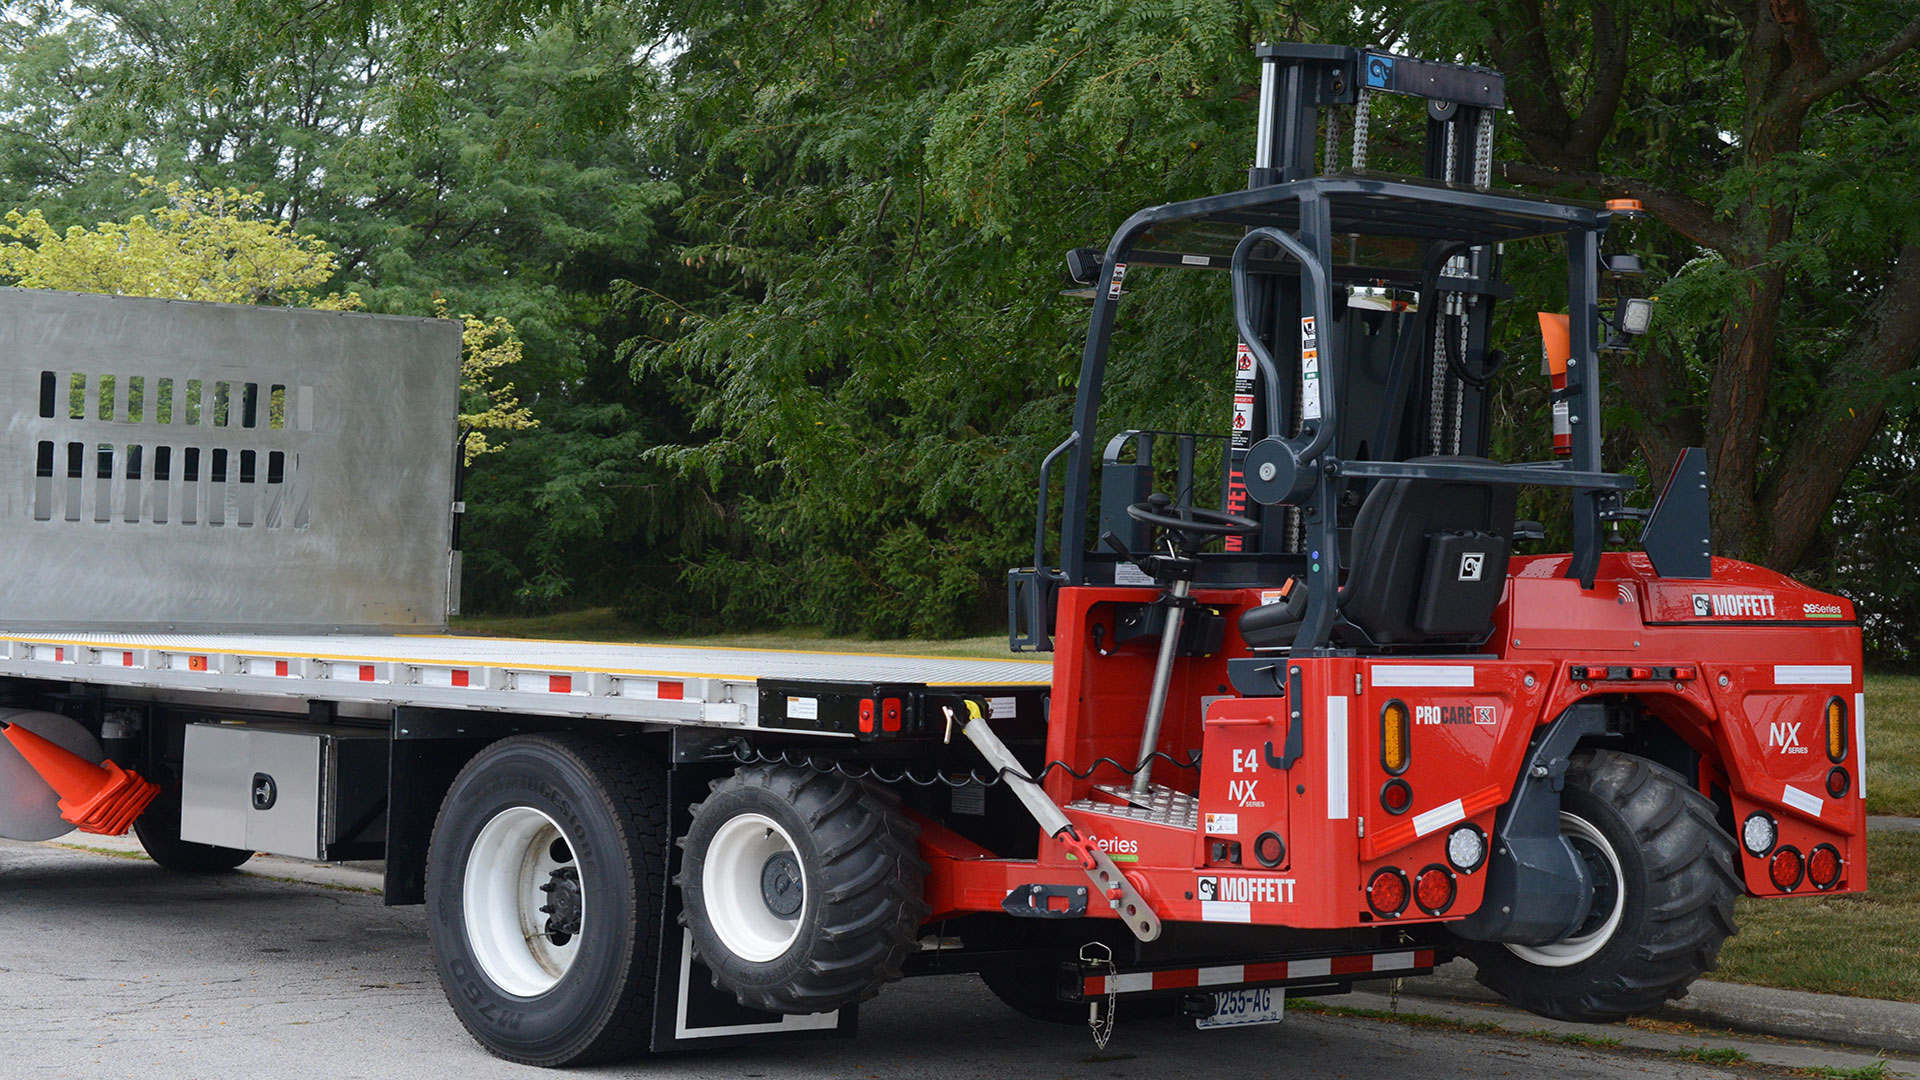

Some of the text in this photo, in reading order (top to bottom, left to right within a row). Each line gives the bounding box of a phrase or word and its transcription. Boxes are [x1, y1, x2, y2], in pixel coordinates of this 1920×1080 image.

[1225, 468, 1247, 552] MFETT
[1712, 594, 1775, 616] MOFFETT
[1416, 706, 1472, 724] PROCARE
[1769, 722, 1801, 754] NX
[1233, 749, 1258, 772] E4
[1228, 780, 1258, 807] NX
[1221, 877, 1296, 903] MOFFETT
[450, 957, 526, 1031] M760
